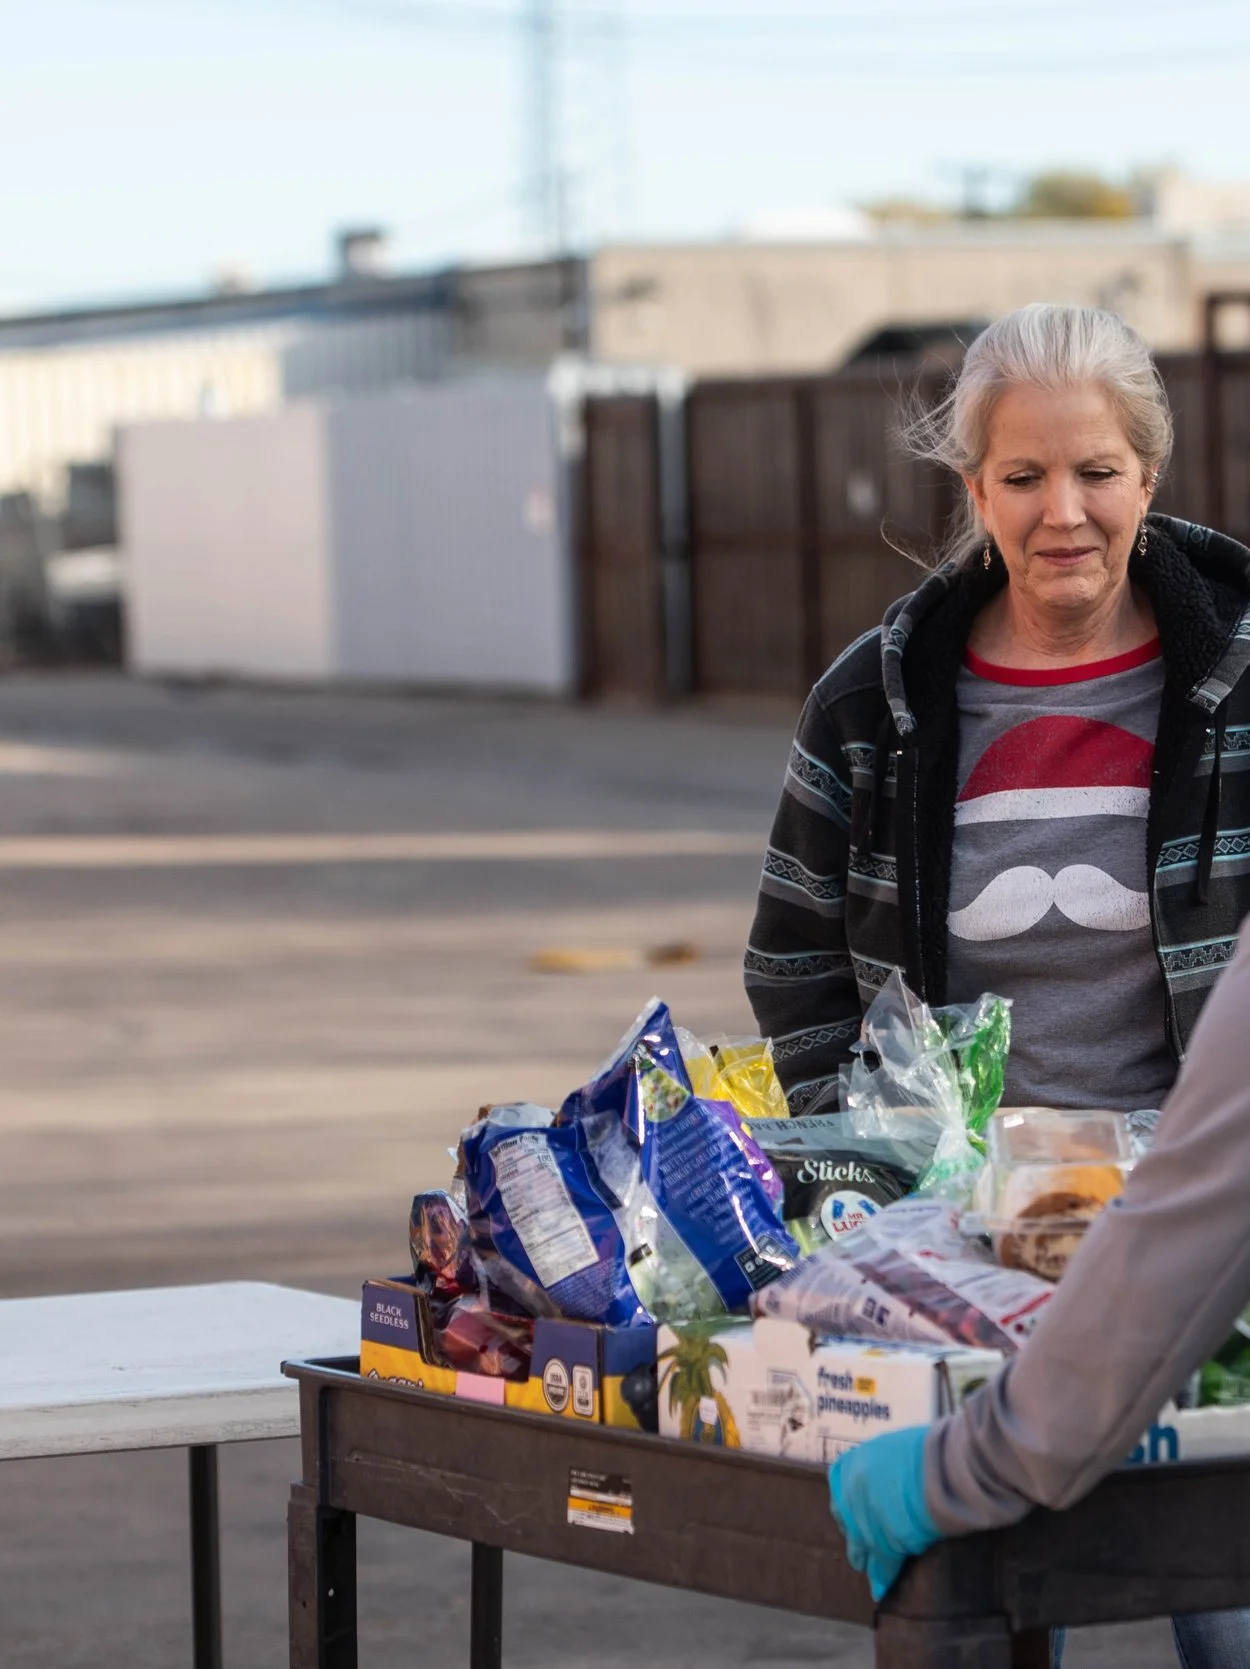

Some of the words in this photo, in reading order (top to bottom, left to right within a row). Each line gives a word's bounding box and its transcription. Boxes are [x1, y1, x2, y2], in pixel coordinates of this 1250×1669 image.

[797, 1159, 876, 1183] Sticks
[369, 1312, 409, 1330] SEEDLESS
[376, 1302, 402, 1317] BLACK
[817, 1366, 854, 1389] fresh
[817, 1393, 891, 1425] pineapples
